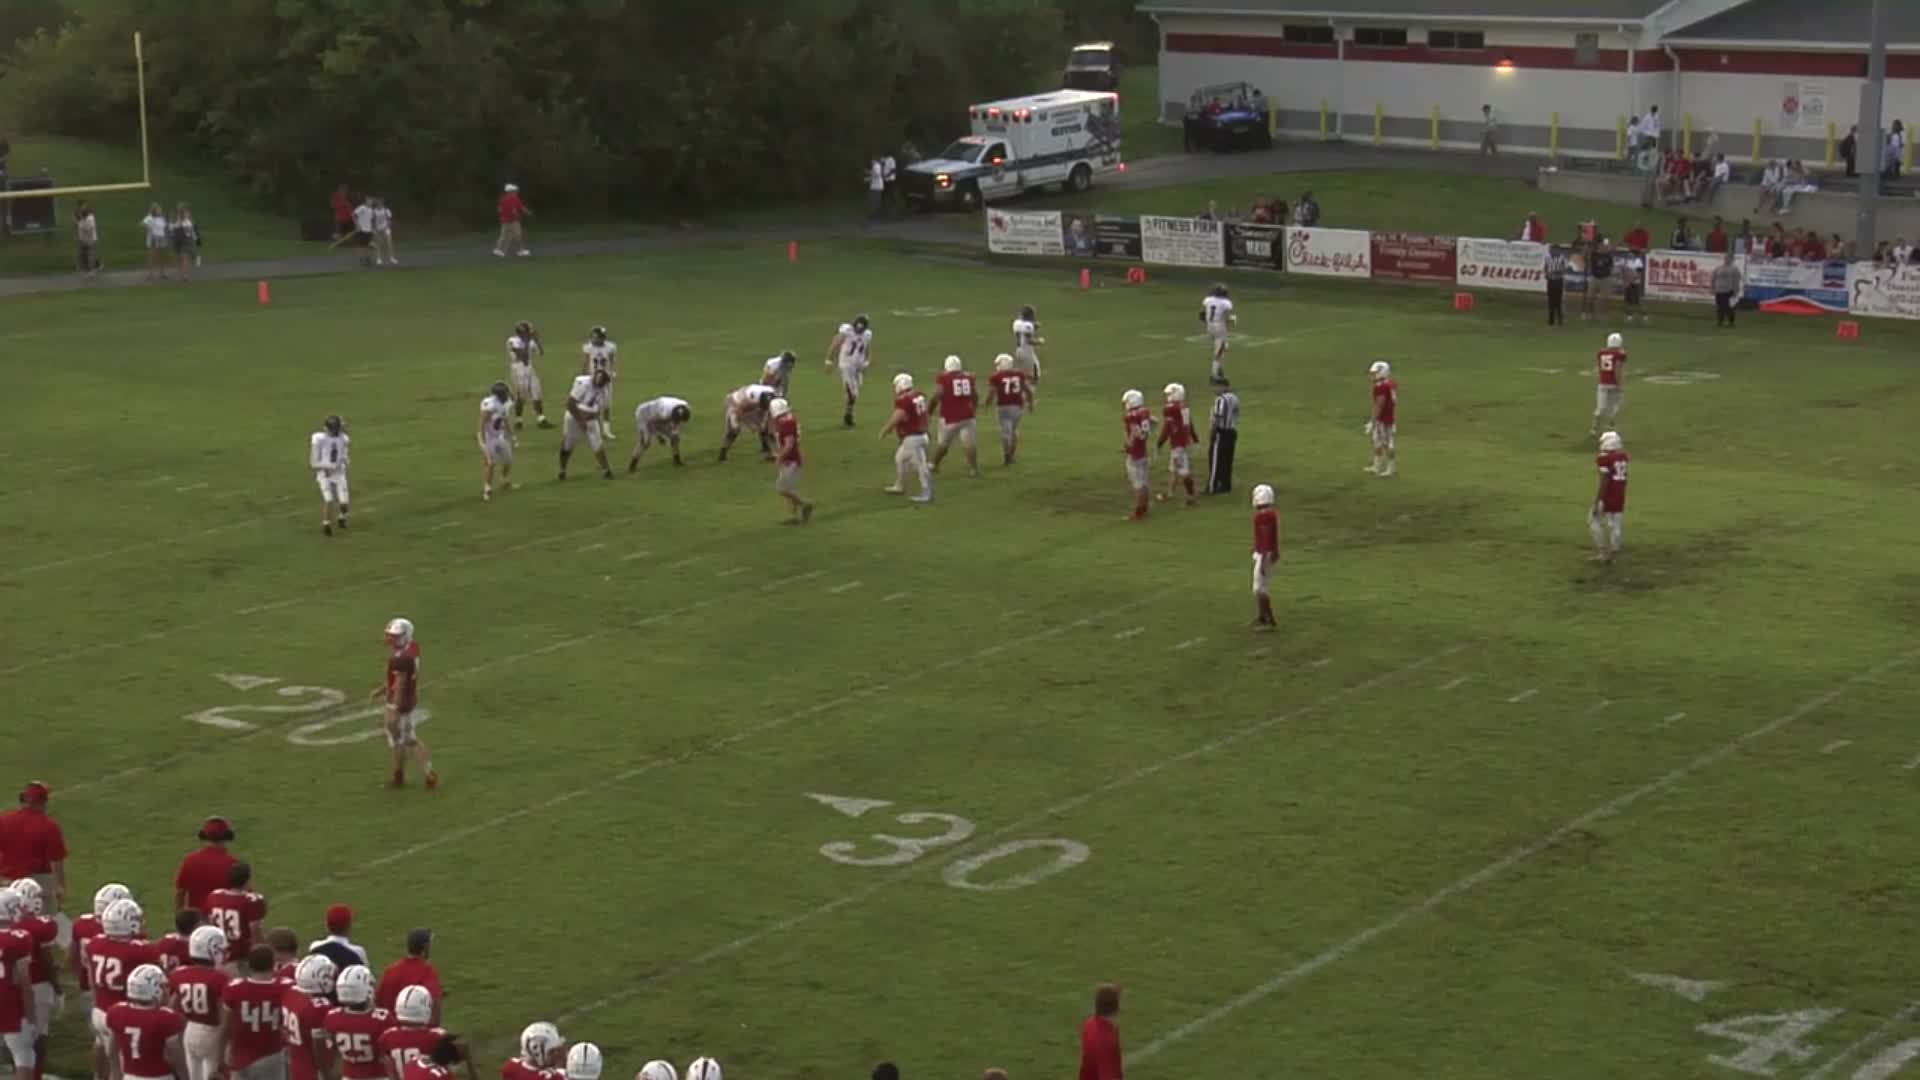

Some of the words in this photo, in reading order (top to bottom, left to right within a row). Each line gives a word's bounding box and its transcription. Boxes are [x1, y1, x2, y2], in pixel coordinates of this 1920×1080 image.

[1460, 264, 1479, 277] GO
[1481, 264, 1543, 282] BEARCATS
[1001, 376, 1021, 395] 73
[818, 812, 1091, 891] 30
[209, 907, 241, 940] 33
[92, 954, 124, 990] 72
[179, 983, 209, 1015] 28
[240, 1000, 280, 1032] 44
[125, 1026, 142, 1059] 7
[335, 1032, 374, 1063] 25
